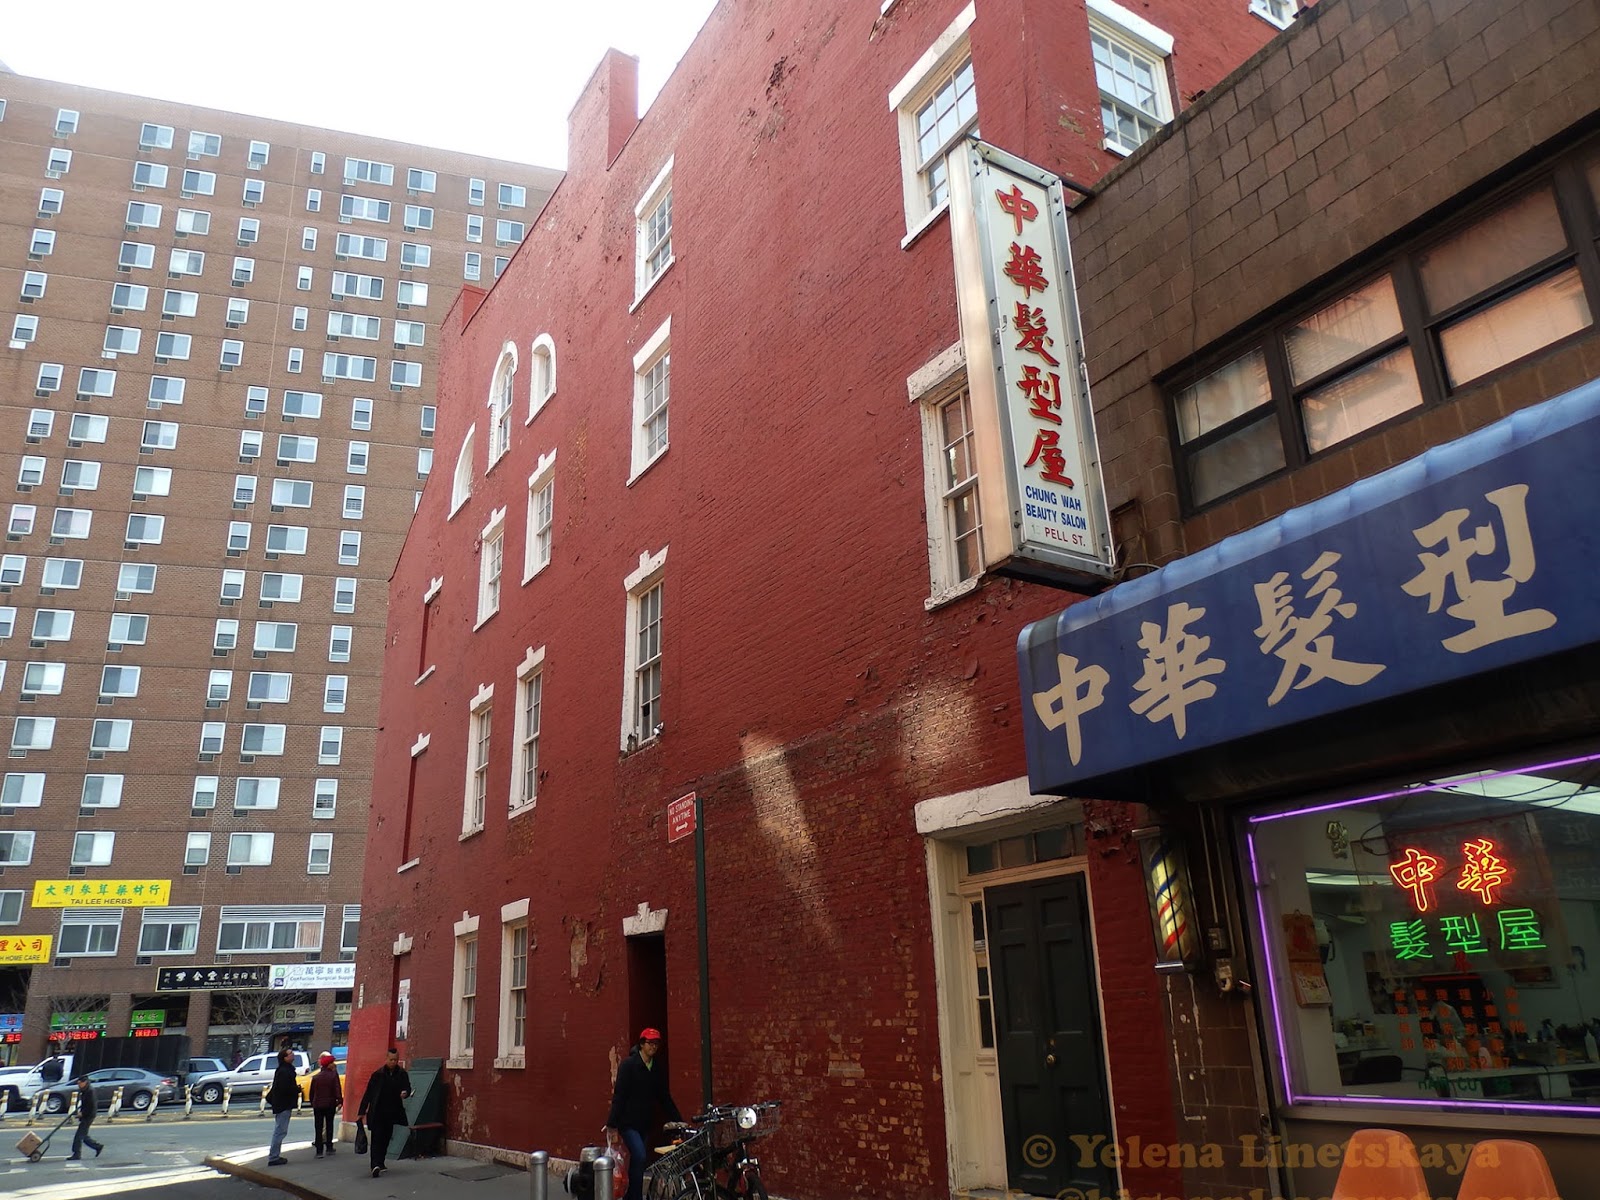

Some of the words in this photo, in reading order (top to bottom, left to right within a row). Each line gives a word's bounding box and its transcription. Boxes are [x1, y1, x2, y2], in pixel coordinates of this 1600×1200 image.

[994, 184, 1074, 489] 中華髮型屋
[1025, 485, 1057, 505] CHUNG
[1061, 494, 1081, 511] WAH
[1025, 503, 1057, 523] BEAUTY
[1061, 512, 1087, 530] SALON
[1045, 527, 1068, 543] PELL
[1072, 533, 1086, 547] ST.
[1032, 483, 1558, 767] 中華髮型
[672, 809, 691, 824] ANYTIME
[1390, 838, 1508, 912] 中華
[1389, 907, 1547, 961] 髮型屋
